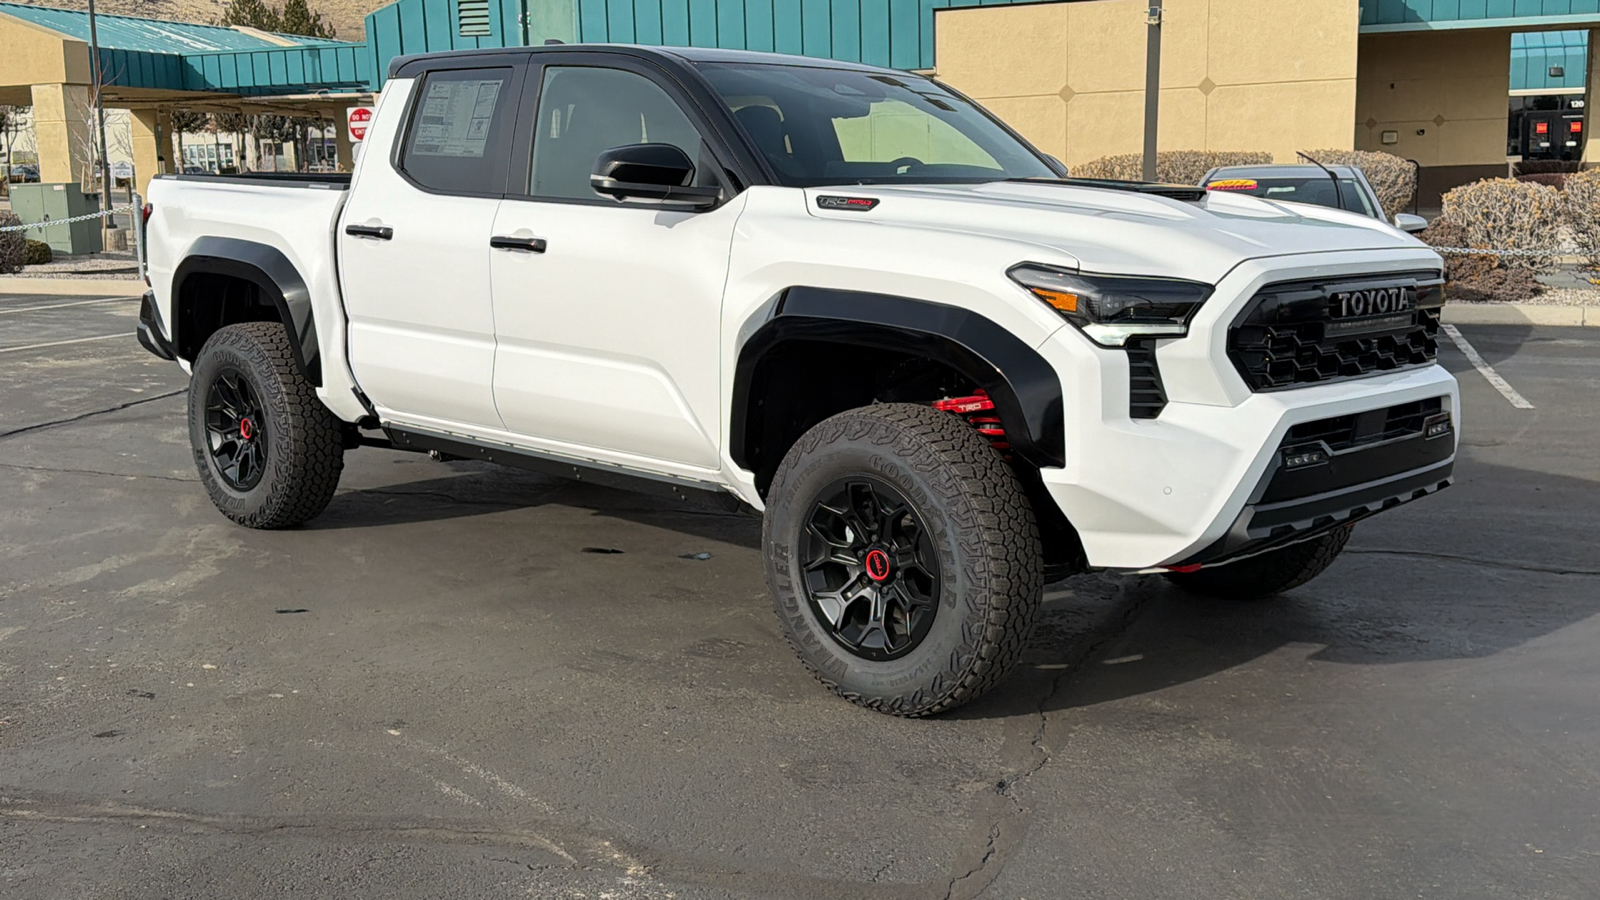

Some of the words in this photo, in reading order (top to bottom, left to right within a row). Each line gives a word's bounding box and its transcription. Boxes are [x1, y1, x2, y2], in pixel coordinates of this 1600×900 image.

[1570, 100, 1585, 108] 120
[820, 197, 848, 205] TRD
[1338, 287, 1409, 317] TOYOTA
[958, 403, 982, 412] TRD
[774, 542, 849, 680] WRANGLER
